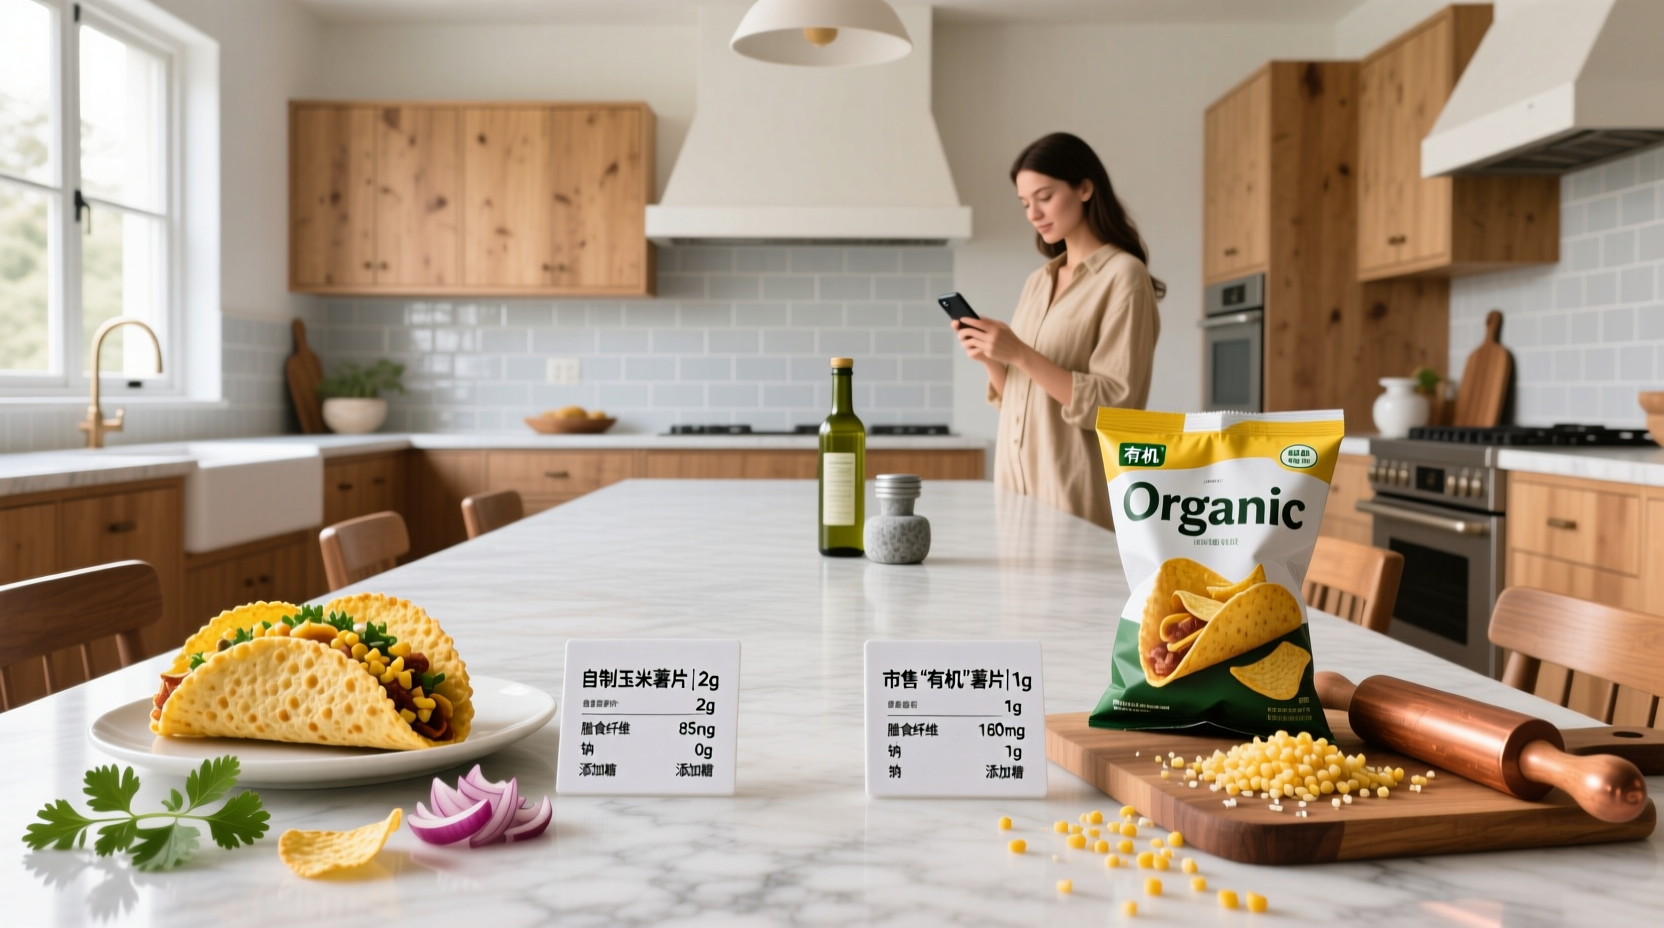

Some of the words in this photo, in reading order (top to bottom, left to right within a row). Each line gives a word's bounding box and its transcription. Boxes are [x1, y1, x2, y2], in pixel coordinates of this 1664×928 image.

[1123, 445, 1159, 464] 有机
[1123, 481, 1306, 537] Organic
[695, 697, 716, 715] 2g
[1004, 699, 1022, 716] 1g
[678, 721, 716, 739] 85ng
[694, 742, 713, 760] 0g
[1004, 744, 1023, 762] 1g
